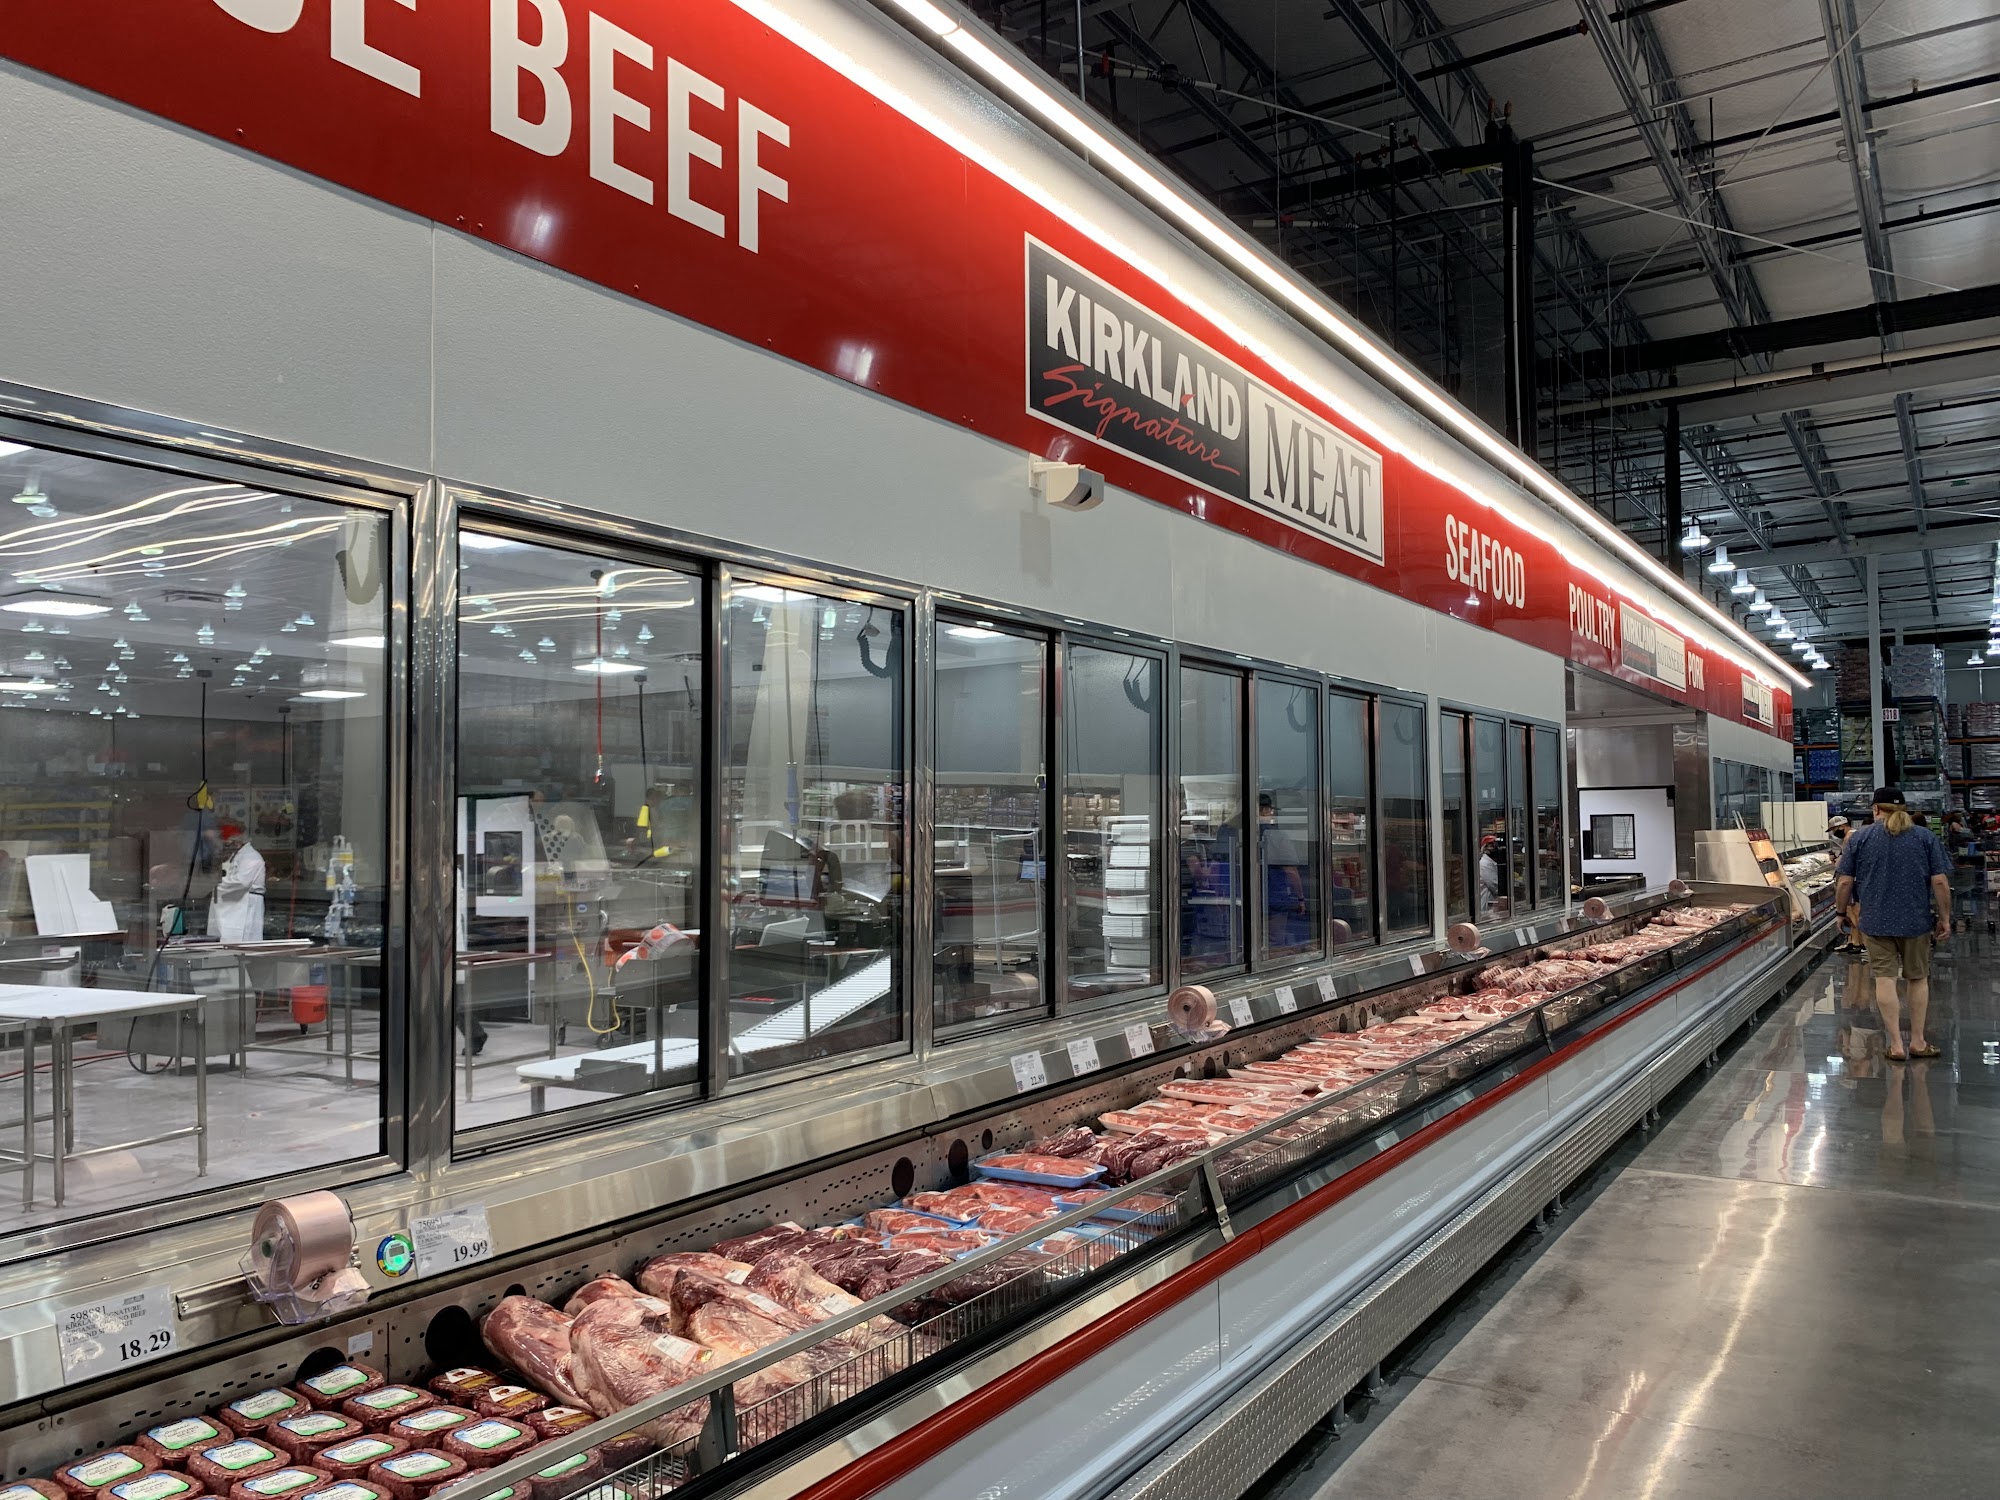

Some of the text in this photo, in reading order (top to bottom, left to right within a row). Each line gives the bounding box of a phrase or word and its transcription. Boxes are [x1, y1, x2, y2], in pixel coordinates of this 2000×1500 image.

[490, 0, 791, 255] BEEF
[1046, 273, 1243, 442] KIRKLAND
[1042, 364, 1241, 477] Signature
[1263, 402, 1371, 543] MEAT
[1445, 513, 1526, 610] SEAFOOD
[1568, 582, 1616, 651] POULTRY
[1687, 650, 1705, 692] PORK
[453, 1239, 488, 1263] 19.99
[65, 1316, 99, 1331] KIRKLA
[119, 1330, 171, 1362] 18.29
[130, 1308, 147, 1319] BEEF
